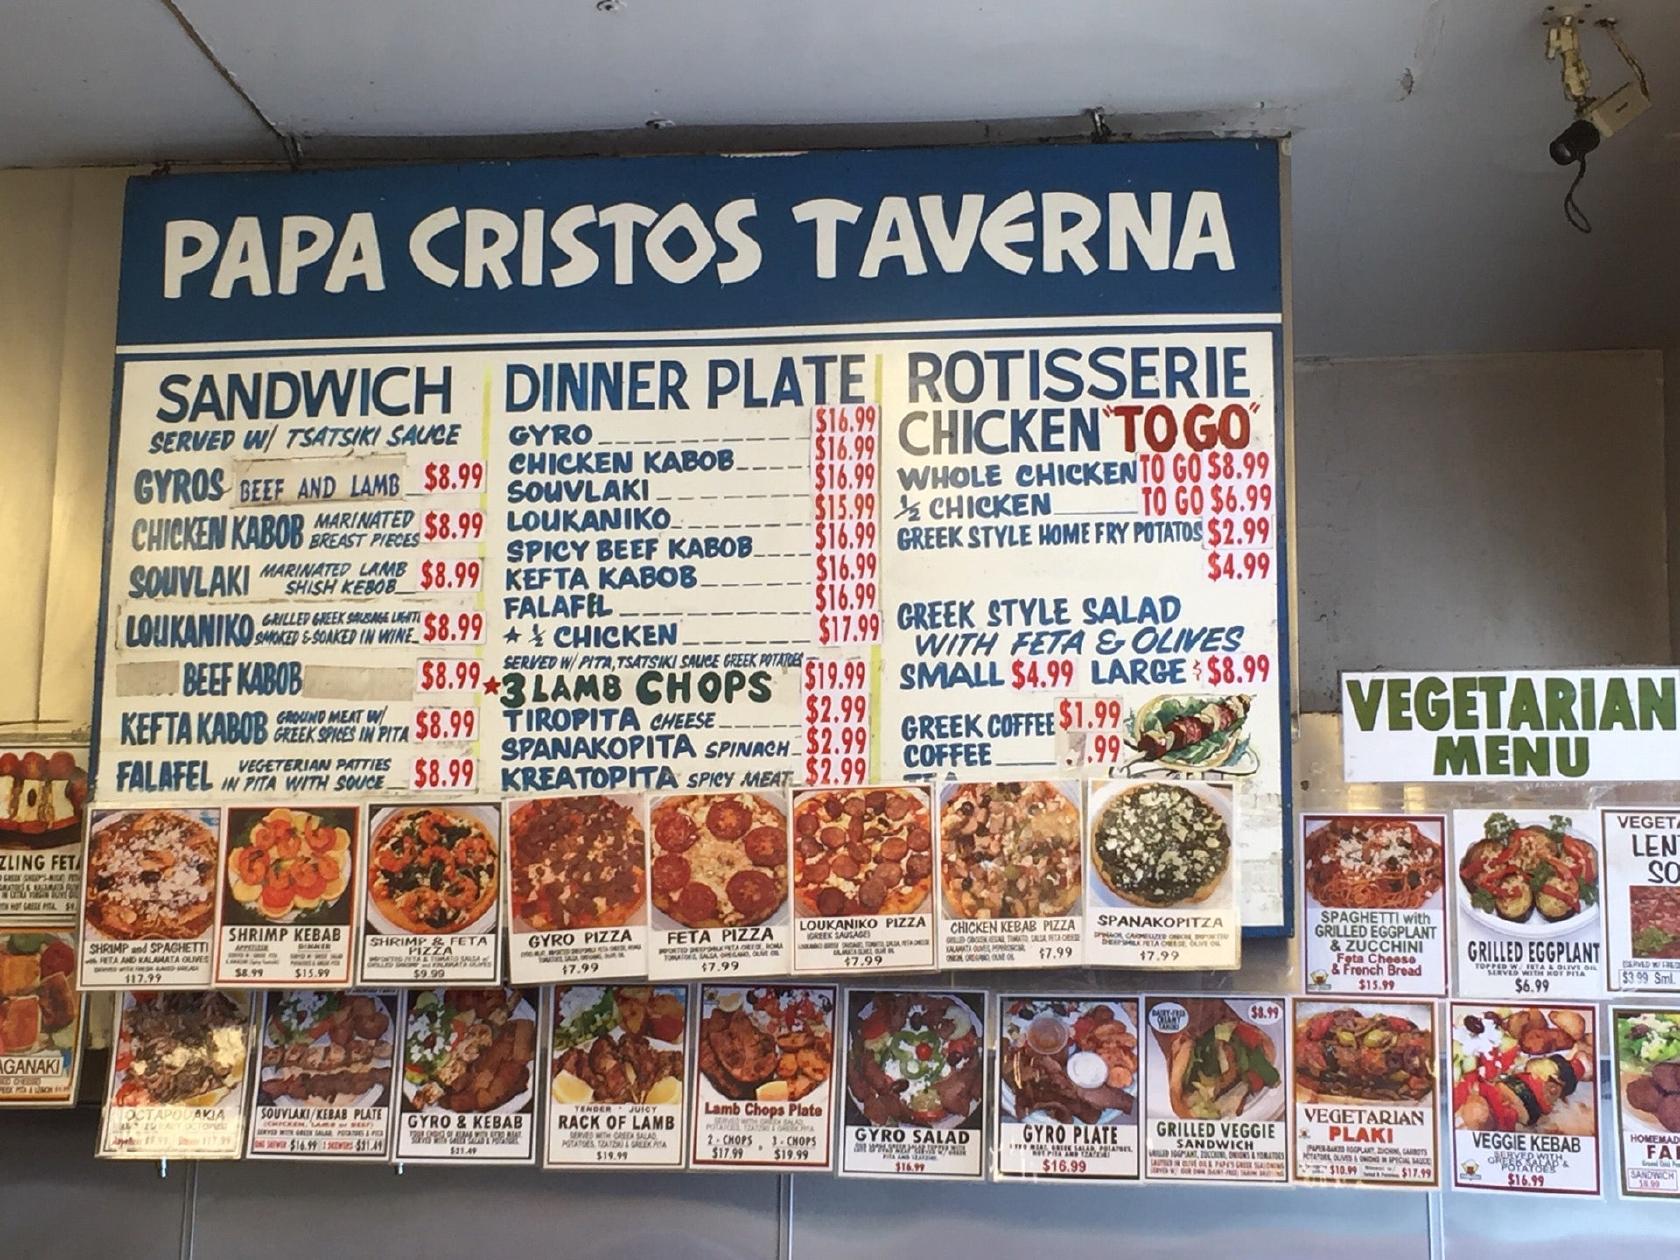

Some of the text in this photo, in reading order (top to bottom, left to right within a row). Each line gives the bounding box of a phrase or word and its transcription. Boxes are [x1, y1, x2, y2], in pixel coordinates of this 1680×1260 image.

[162, 188, 1236, 298] PAPA CRISTOS TAVERNA
[506, 354, 865, 412] DINNER PLATE
[908, 346, 1250, 403] ROTISSERIE
[156, 366, 452, 423] SANDWICH
[509, 406, 875, 446] GYRO $16.99
[899, 407, 1098, 455] CHICKEN
[148, 424, 461, 454] SERVED TSATSIKI SAUCE
[644, 450, 734, 473] KABOB
[898, 451, 1200, 490] WHOLE CHICKEN TO GO
[134, 461, 483, 504] GYROS BEEF AND LAMB $8.99
[507, 478, 649, 503] SOUVLAKI
[930, 484, 1272, 519] CHICKEN $6.99
[314, 511, 415, 528] MARINATED
[507, 492, 875, 531] LOUKANIKO $15.99
[309, 533, 419, 550] BREAST PIECES
[506, 521, 876, 562] SPICY KABOB $16.99
[898, 517, 1270, 550] GREEK STYLE HOME FRY POTATOS $2.99
[1208, 552, 1270, 581] $4.99
[129, 560, 480, 598] SOUVLAKI $8.99
[506, 565, 697, 591] KEFTA KABOB
[285, 580, 396, 596] SHISH KEBOB
[816, 583, 876, 612] $16.99
[262, 612, 389, 626] GRILLED GREEK SAUSAGE
[1082, 596, 1180, 625] SALAD
[820, 614, 880, 643] $17.99
[255, 629, 412, 646] SMOKED IN WINE
[915, 625, 1244, 656] WITH FETA OLIVES
[183, 660, 480, 696] BEEF $8.99
[900, 658, 1186, 689] SMALL LARGE
[500, 658, 865, 708] 3 LAMB CHOPS $19.99
[1346, 676, 1677, 731] VEGETARIAN
[276, 711, 363, 725] GROUND MEAT
[504, 707, 716, 732] TIROPITA CHEESE
[902, 698, 1122, 740] GREEK COFFEE $1.99
[120, 711, 268, 745] KEFTA KABOB
[317, 727, 409, 742] SPICES PITA
[501, 734, 789, 760] SPANAKOPITA SPINACH
[1433, 735, 1589, 778] MENU
[239, 759, 392, 772] VEGETERIAN PATTIES
[502, 757, 866, 791] KREATOPITA $2.99
[116, 761, 213, 792] FALAFEL
[244, 776, 384, 791] PITA SOUCE
[800, 918, 926, 931] LOUKANIKO PIZZA
[1098, 915, 1224, 928] SPANAKOPITZA
[1320, 911, 1431, 925] SPAGHETTI with
[229, 928, 341, 943] SHRIMP KEBAB
[950, 920, 1075, 934] CHICKEN KEBAB PIZZA
[1370, 926, 1437, 939] EGGPLANT
[370, 937, 487, 946] SHRIMP FETA
[529, 930, 632, 947] GYRO PIZZA
[667, 930, 710, 944] FETA
[89, 942, 208, 954] SHRIMP SPAGHETTI
[409, 946, 453, 955] PIZZA
[1039, 948, 1072, 960] $7.99
[1345, 940, 1423, 953] ZUCCHINI
[1468, 941, 1523, 963] GRILLED
[845, 956, 883, 967] $7.99
[1337, 953, 1416, 964] Feta Cheese
[235, 968, 264, 977] $8.99
[414, 970, 445, 978] $9.99
[562, 964, 598, 975] $7.99
[1343, 964, 1422, 977] French Bread
[1359, 980, 1395, 991] $15.99
[1515, 978, 1549, 993] $6.99
[354, 1107, 382, 1120] PLATE
[705, 1103, 822, 1118] Lamb Chops Plate
[1305, 1109, 1424, 1125] VEGETARIAN
[473, 1115, 523, 1128] KEBAB
[559, 1115, 674, 1130] RACK OF LAMB
[1157, 1121, 1275, 1138] GRILLED VEGGIE
[787, 1136, 816, 1146] CHOPS
[855, 1128, 970, 1144] GYRO SALAD
[1023, 1124, 1118, 1144] GYRO PLATE
[1329, 1126, 1392, 1143] PLAKI
[1473, 1133, 1581, 1152] VEGGIE KEBAB
[1177, 1139, 1254, 1150] SANDWICH
[596, 1151, 628, 1160] $19.99
[774, 1150, 808, 1160] $19.99
[1402, 1168, 1431, 1178] $17.99
[1508, 1173, 1544, 1186] $16.99
